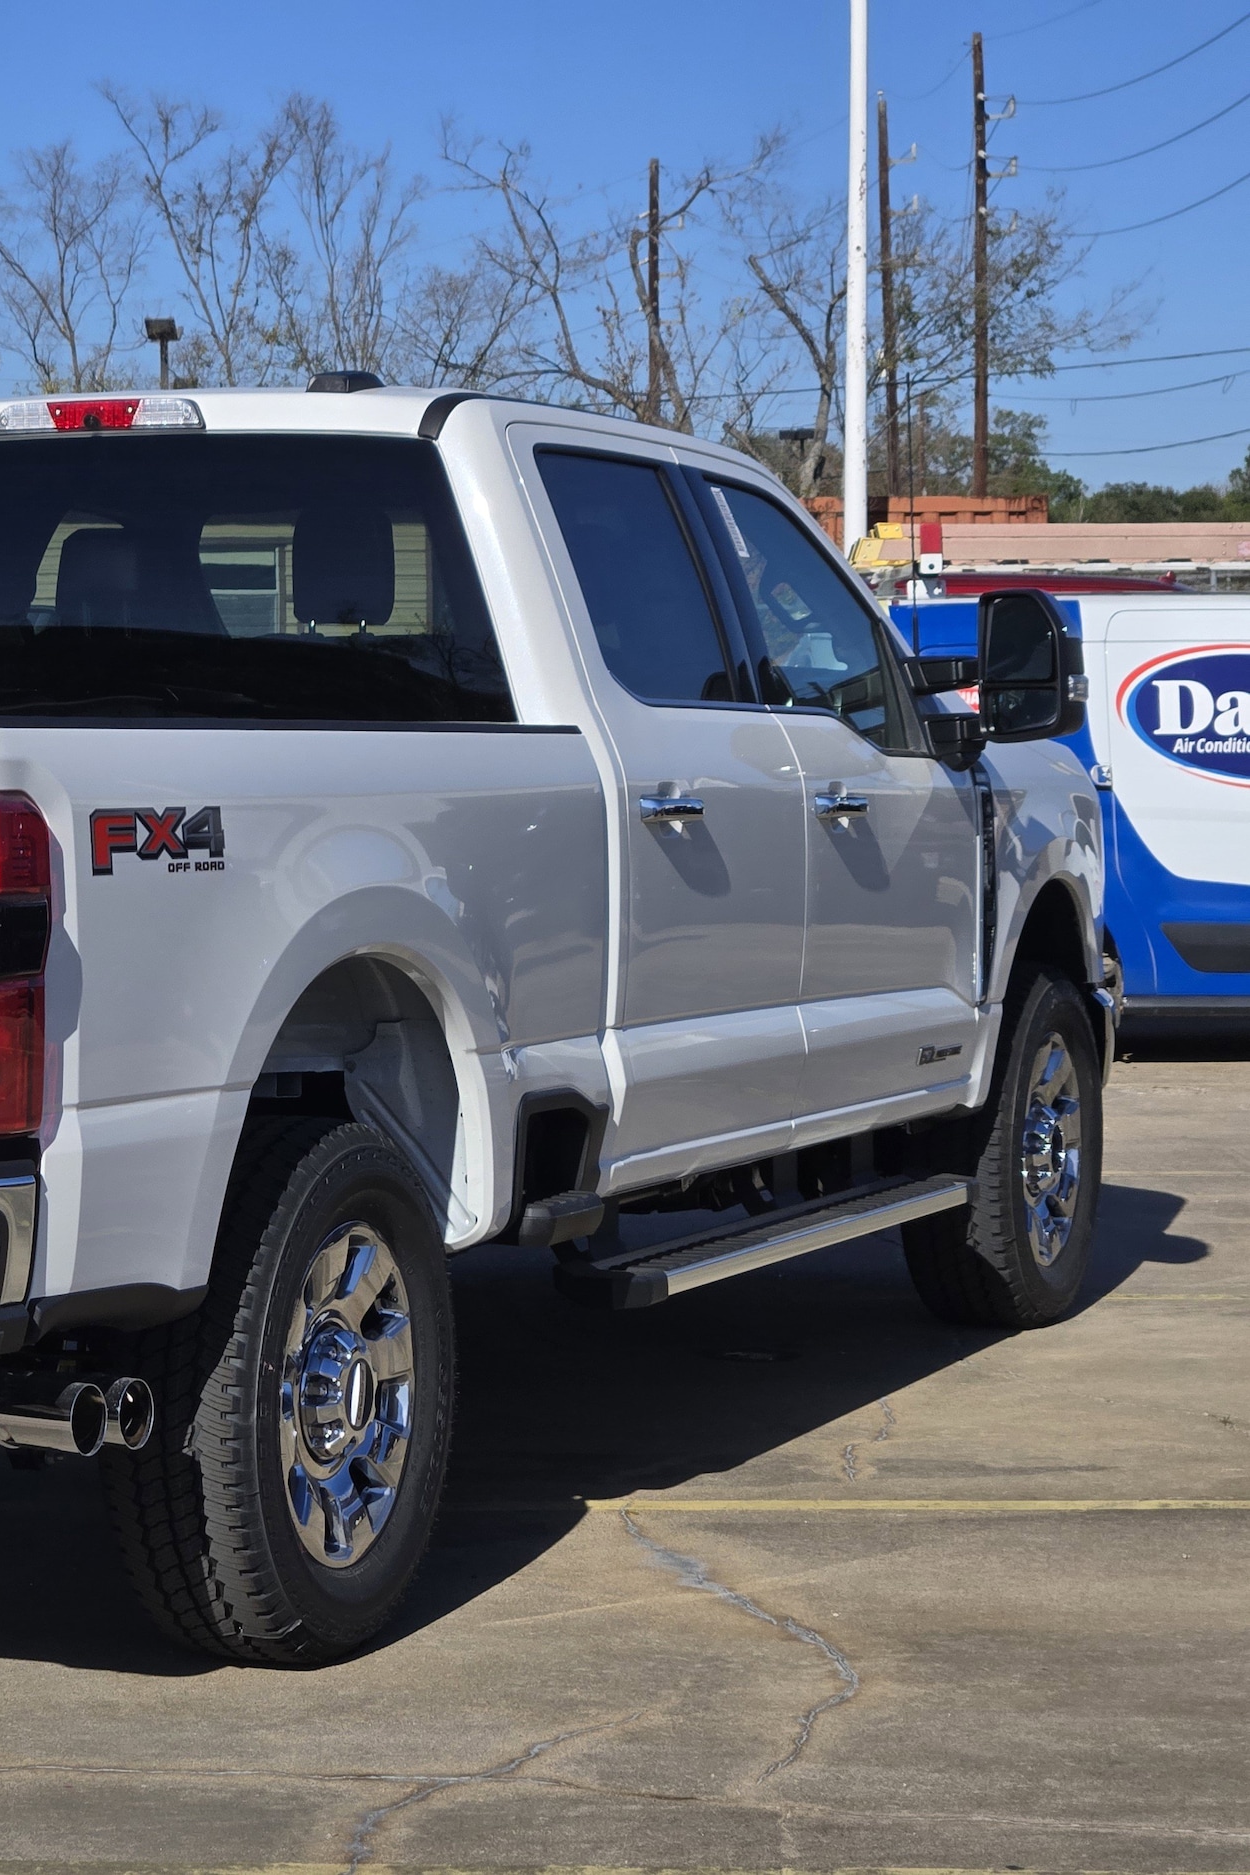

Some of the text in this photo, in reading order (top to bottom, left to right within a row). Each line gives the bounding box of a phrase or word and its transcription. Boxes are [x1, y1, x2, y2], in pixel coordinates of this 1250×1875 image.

[1172, 737, 1196, 753] Air
[89, 806, 226, 876] FX4
[168, 861, 225, 873] OFF ROAD
